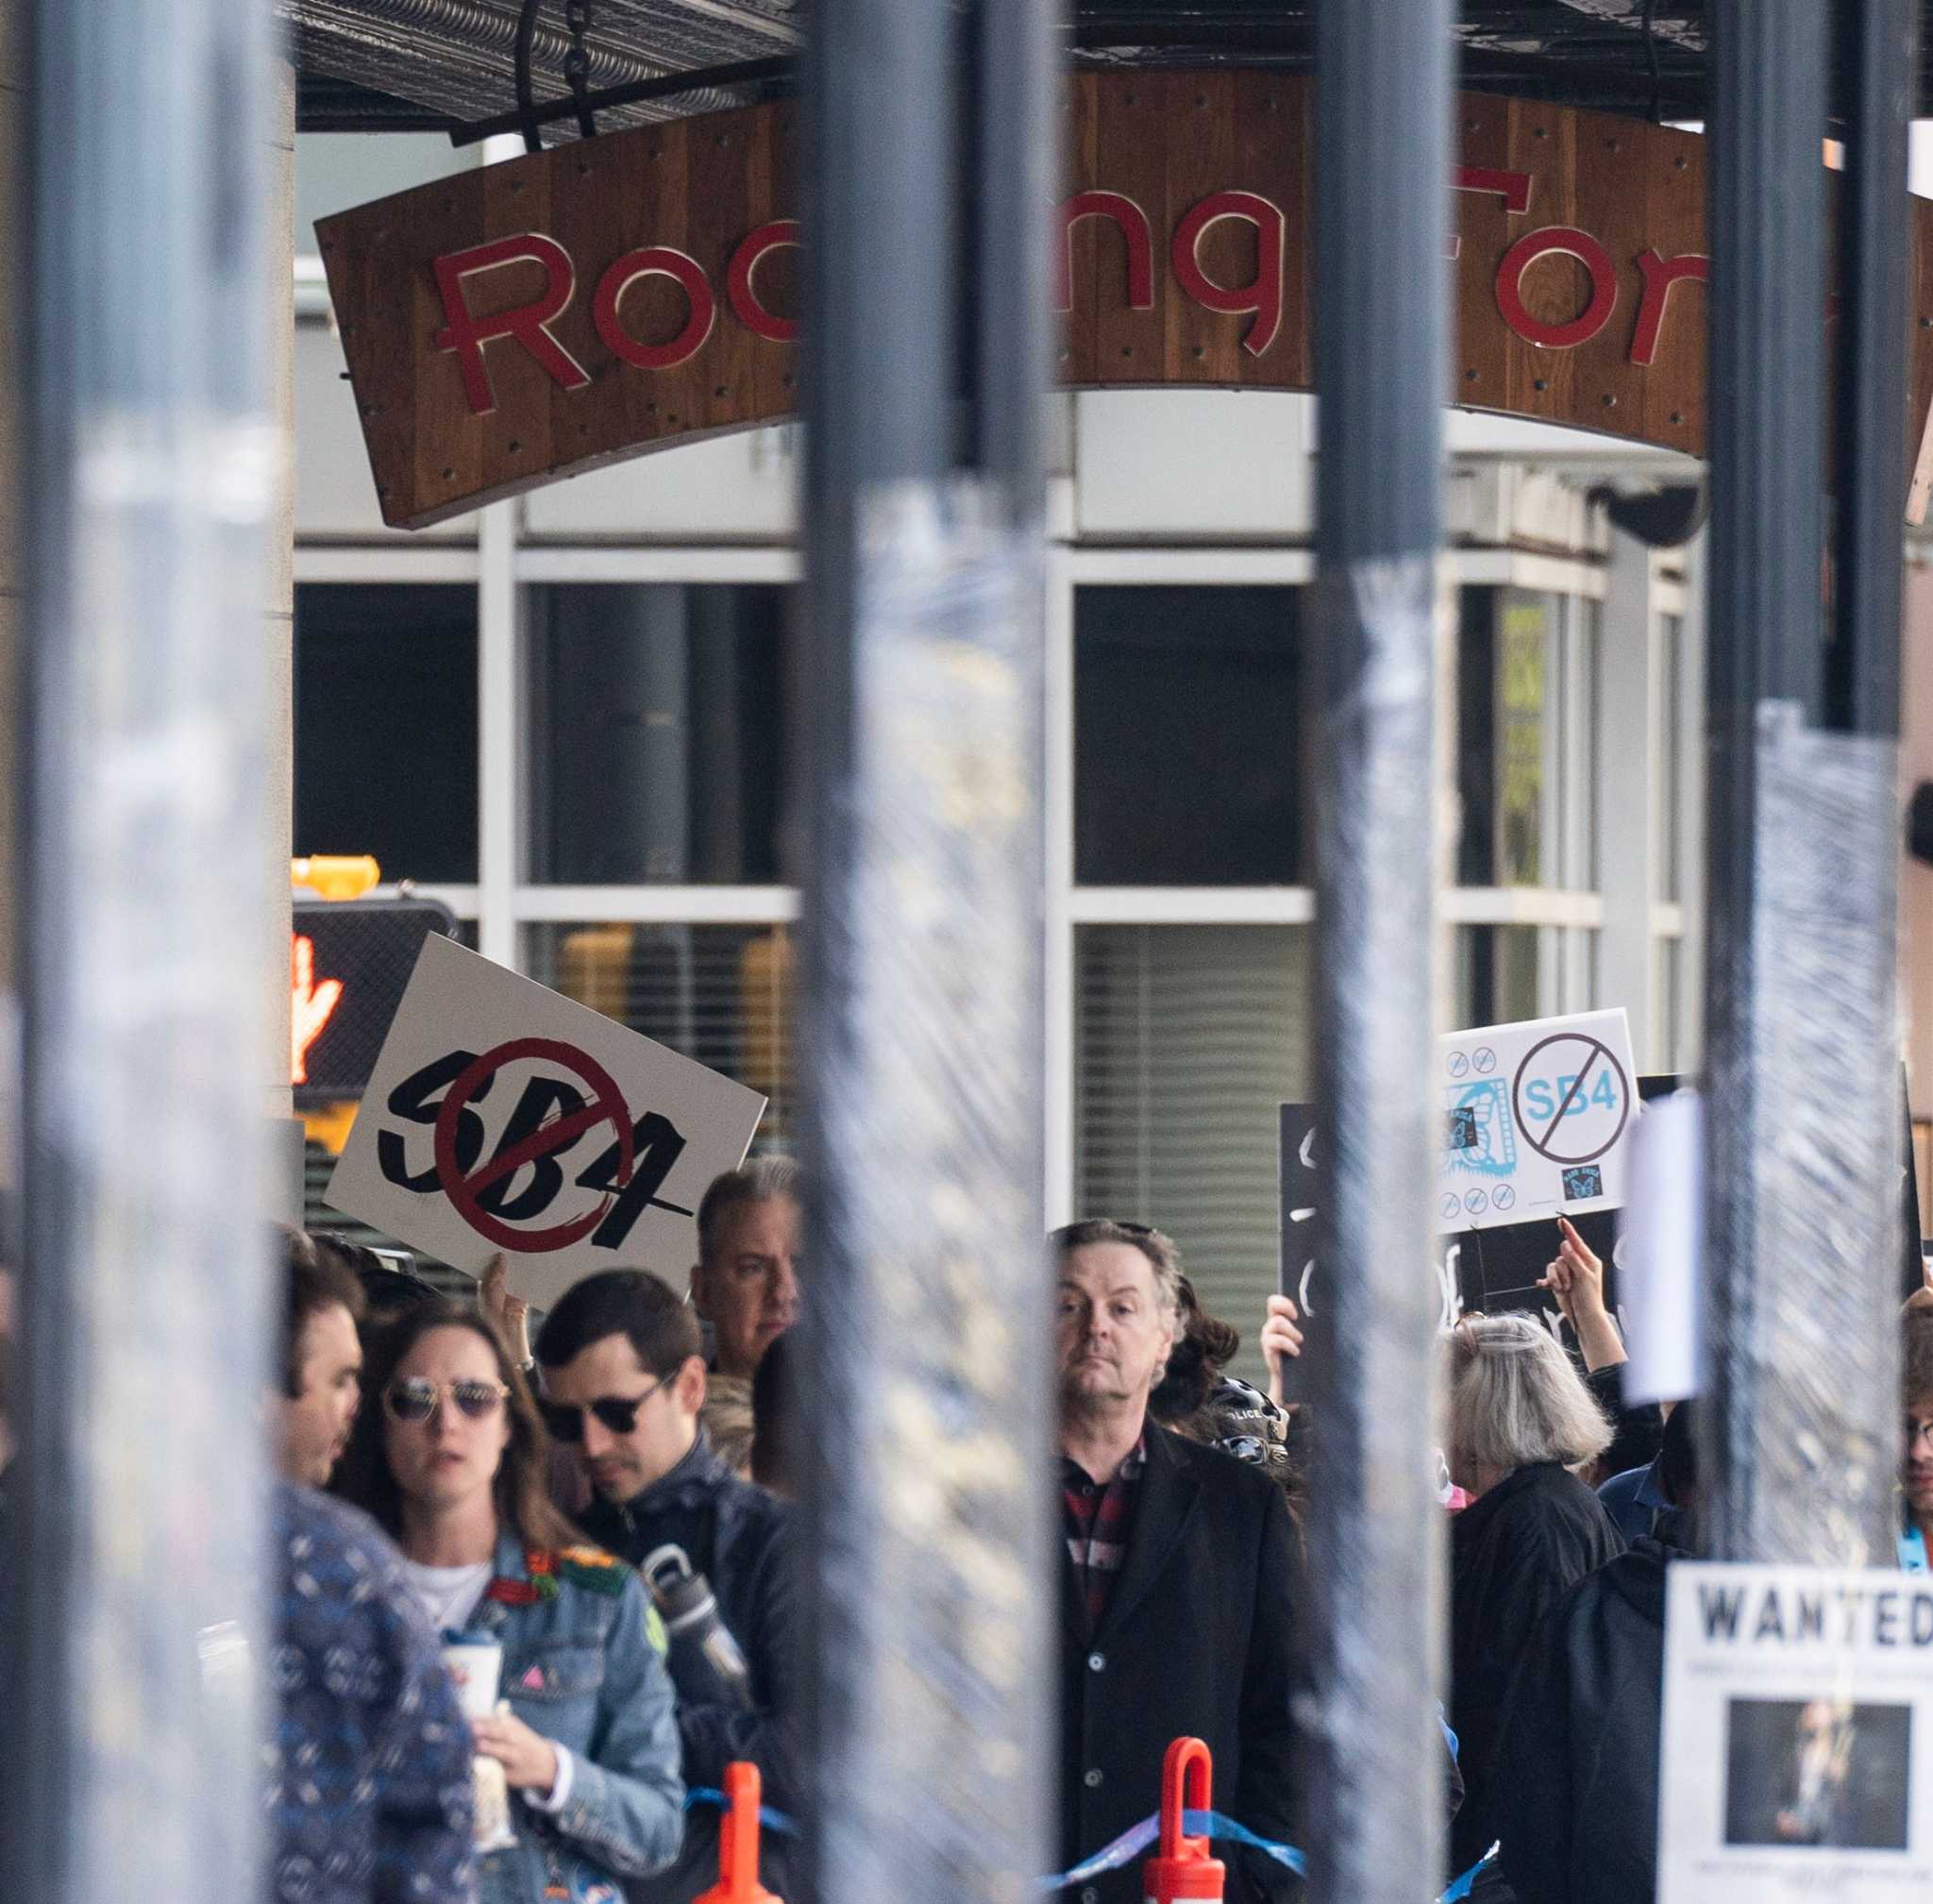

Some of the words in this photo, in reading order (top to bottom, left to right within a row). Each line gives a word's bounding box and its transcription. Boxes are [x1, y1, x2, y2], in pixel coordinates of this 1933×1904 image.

[433, 190, 1285, 415] Roong
[378, 1050, 695, 1250] SB4
[1524, 1070, 1617, 1121] SB4
[1697, 1583, 1933, 1646] WANTED
